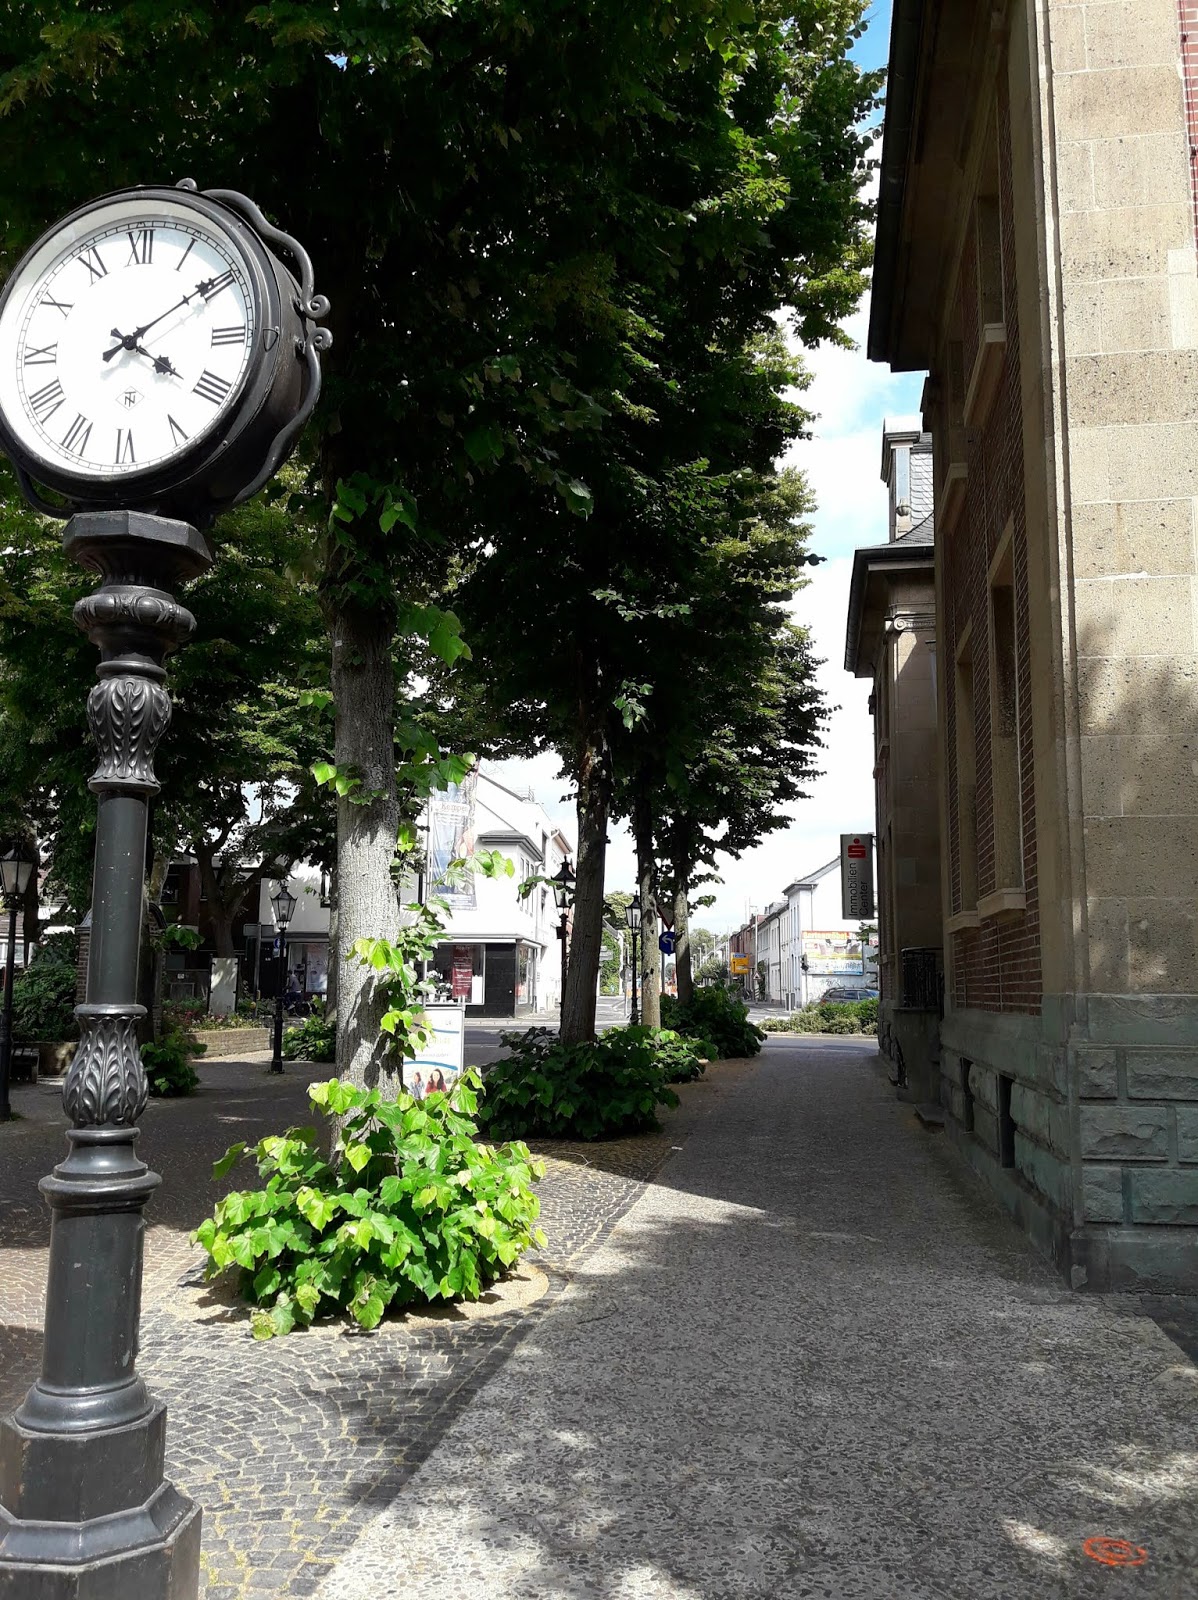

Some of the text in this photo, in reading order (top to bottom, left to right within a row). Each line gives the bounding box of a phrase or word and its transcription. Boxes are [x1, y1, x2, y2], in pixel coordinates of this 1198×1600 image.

[125, 228, 155, 267] XII
[76, 245, 110, 287] XI
[39, 289, 75, 320] X
[211, 323, 246, 348] III
[24, 341, 58, 367] IX
[28, 376, 67, 425] VIII
[60, 412, 94, 457] VII
[115, 428, 136, 464] VI
[167, 413, 189, 447] V
[847, 862, 858, 916] Immobilien
[859, 880, 869, 916] Center
